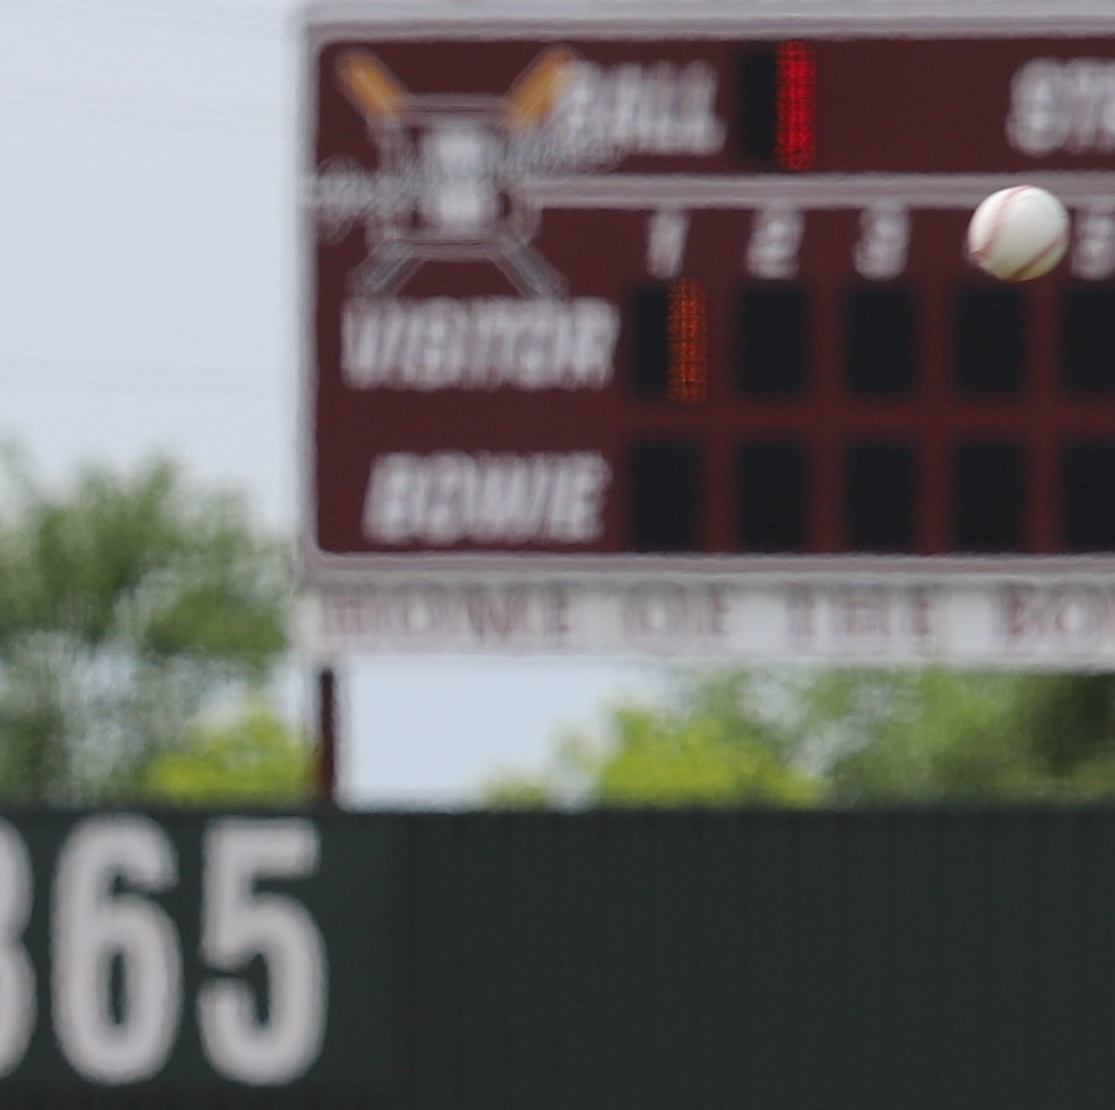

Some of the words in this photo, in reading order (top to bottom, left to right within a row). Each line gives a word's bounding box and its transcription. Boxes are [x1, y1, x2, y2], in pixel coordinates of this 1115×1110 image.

[775, 40, 817, 170] 1
[646, 206, 688, 280] 1
[747, 206, 804, 281] 2
[853, 206, 911, 281] 3
[341, 296, 620, 392] VISITOR
[362, 450, 612, 546] BOWIE
[320, 580, 574, 652] HOME
